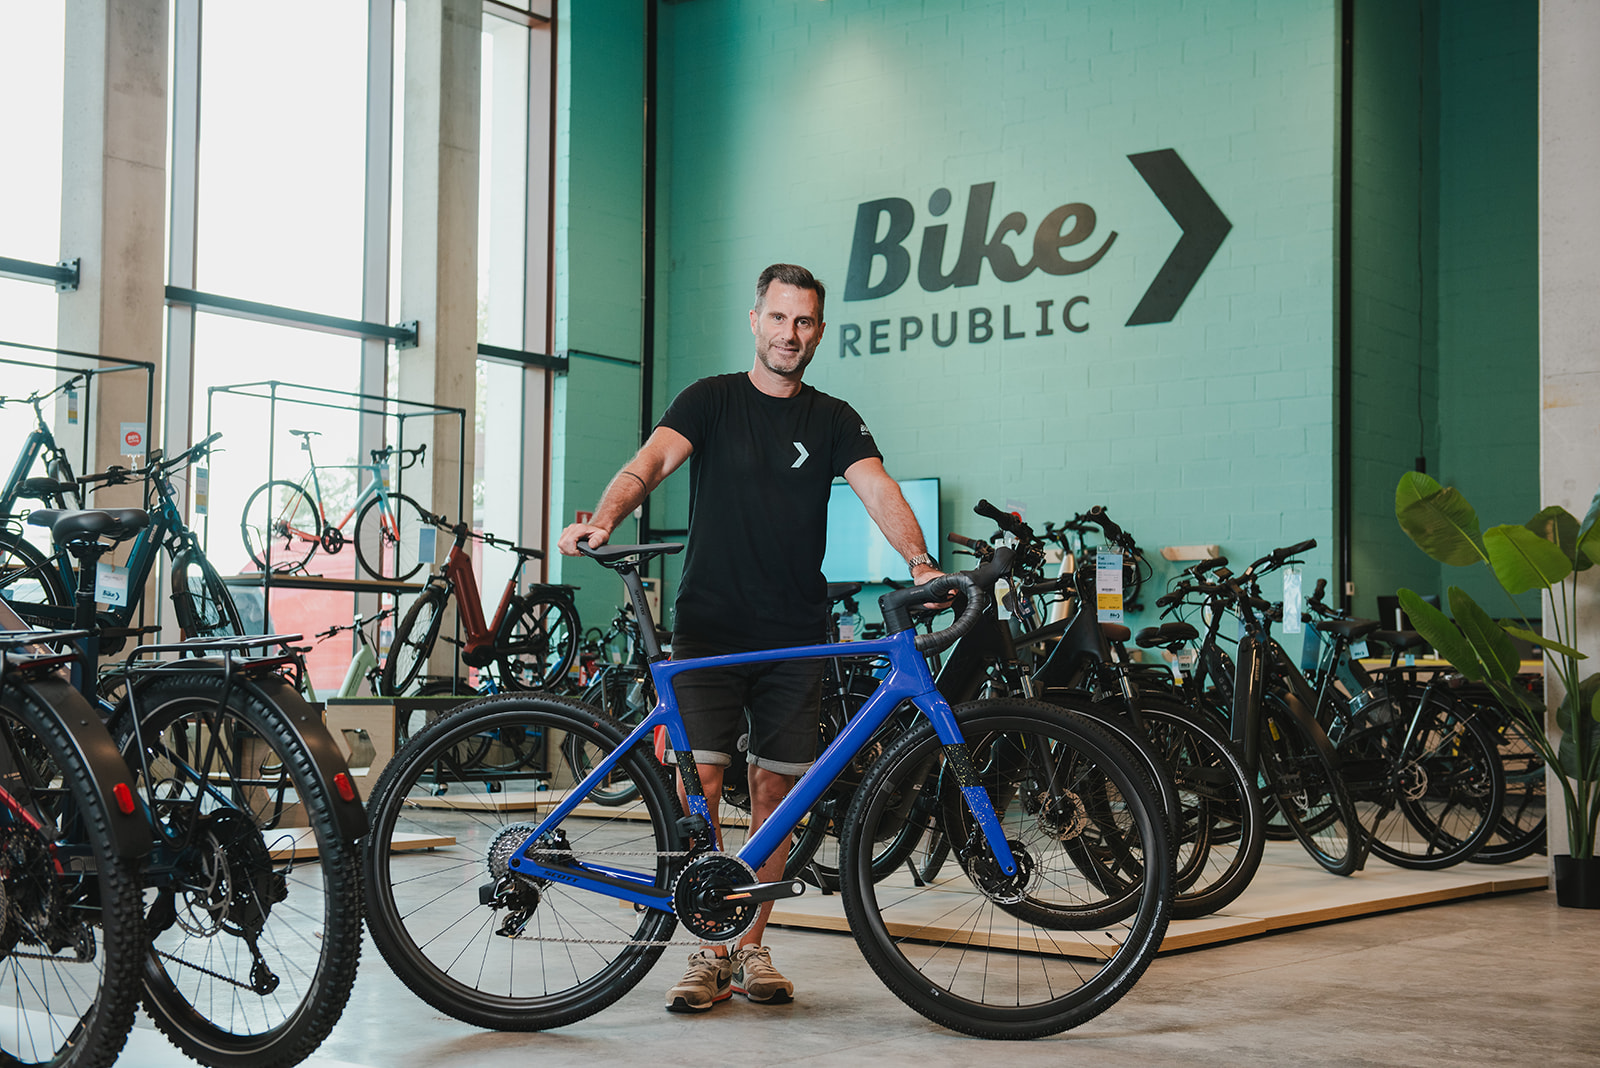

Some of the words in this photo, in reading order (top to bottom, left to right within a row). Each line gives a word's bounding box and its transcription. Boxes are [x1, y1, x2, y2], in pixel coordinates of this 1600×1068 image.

[843, 181, 1119, 302] Bike
[839, 295, 1091, 359] REPUBLIC
[544, 870, 579, 883] SCOTT
